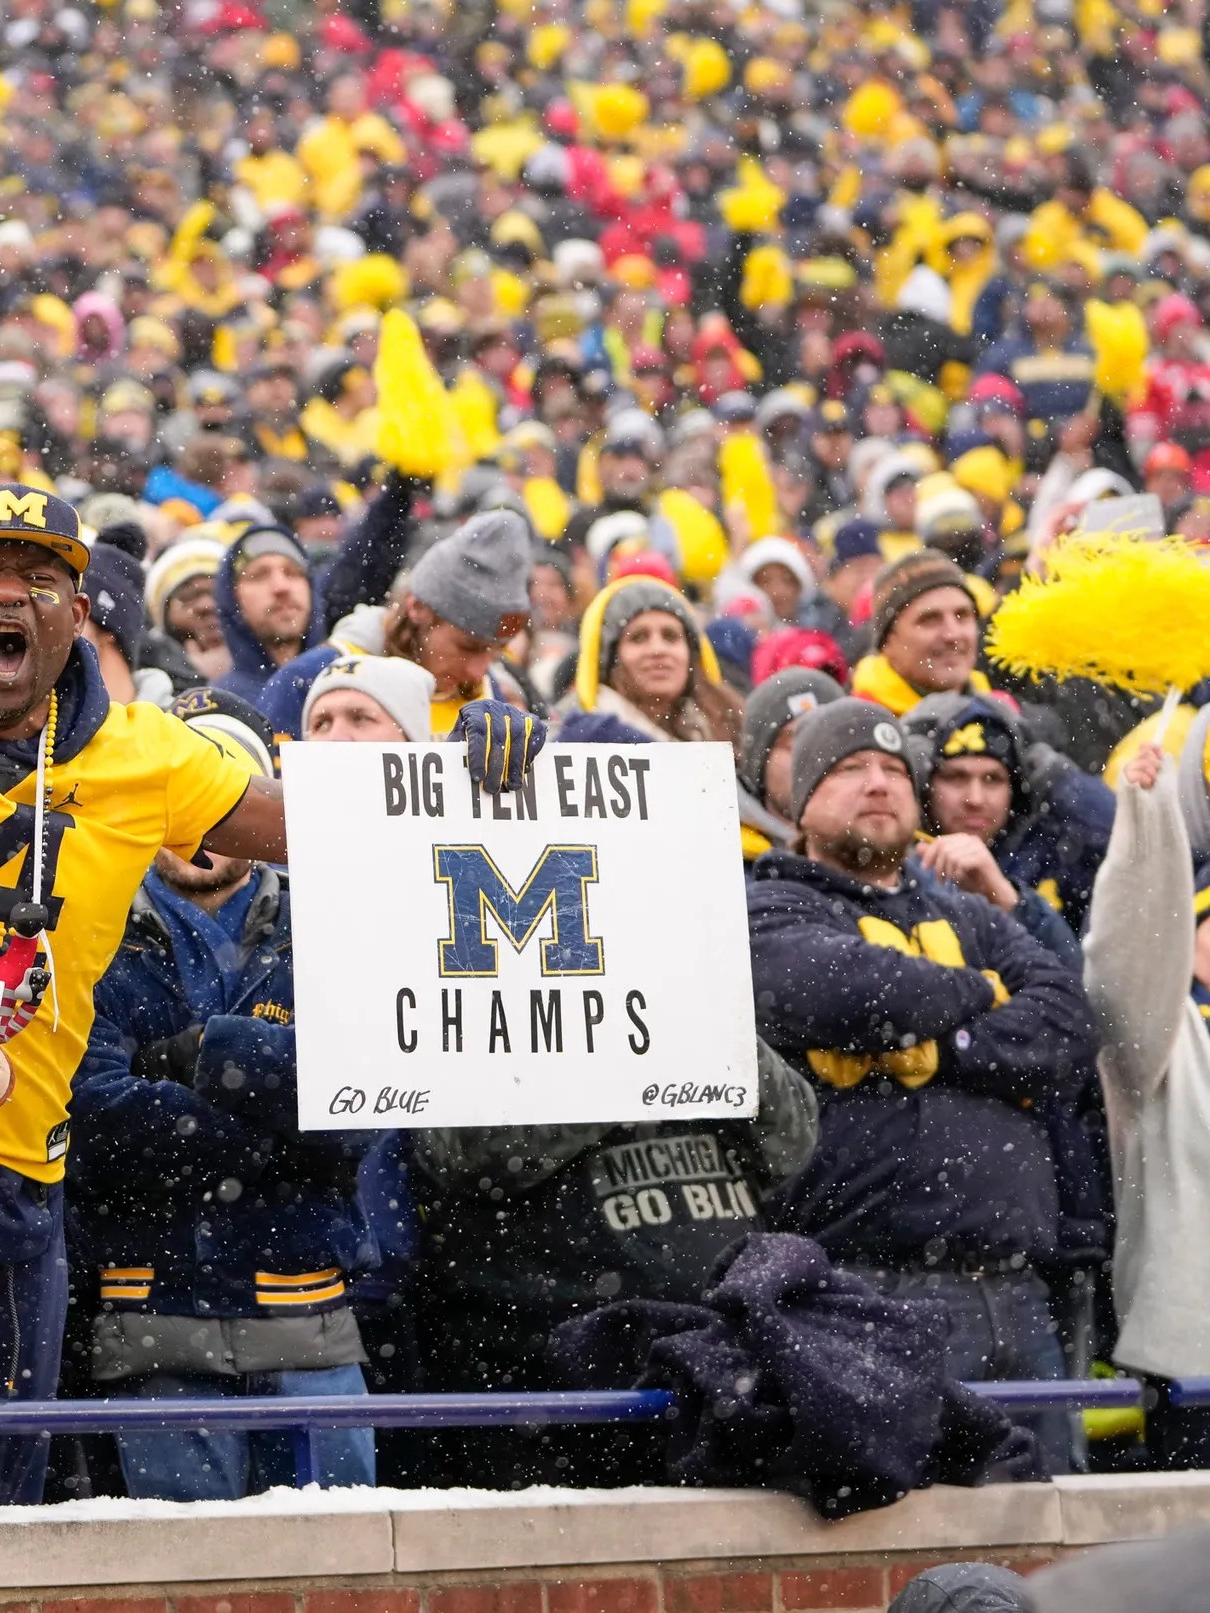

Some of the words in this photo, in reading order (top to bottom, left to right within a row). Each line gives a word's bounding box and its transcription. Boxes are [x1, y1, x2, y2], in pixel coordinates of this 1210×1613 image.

[382, 752, 445, 818] BIG
[554, 754, 651, 821] EAST
[432, 843, 606, 978] M
[395, 987, 651, 1055] CHAMPS
[328, 1086, 367, 1115] GO
[373, 1086, 431, 1115] BLUE
[642, 1082, 748, 1108] @GBLANC3
[603, 1188, 673, 1231] GO
